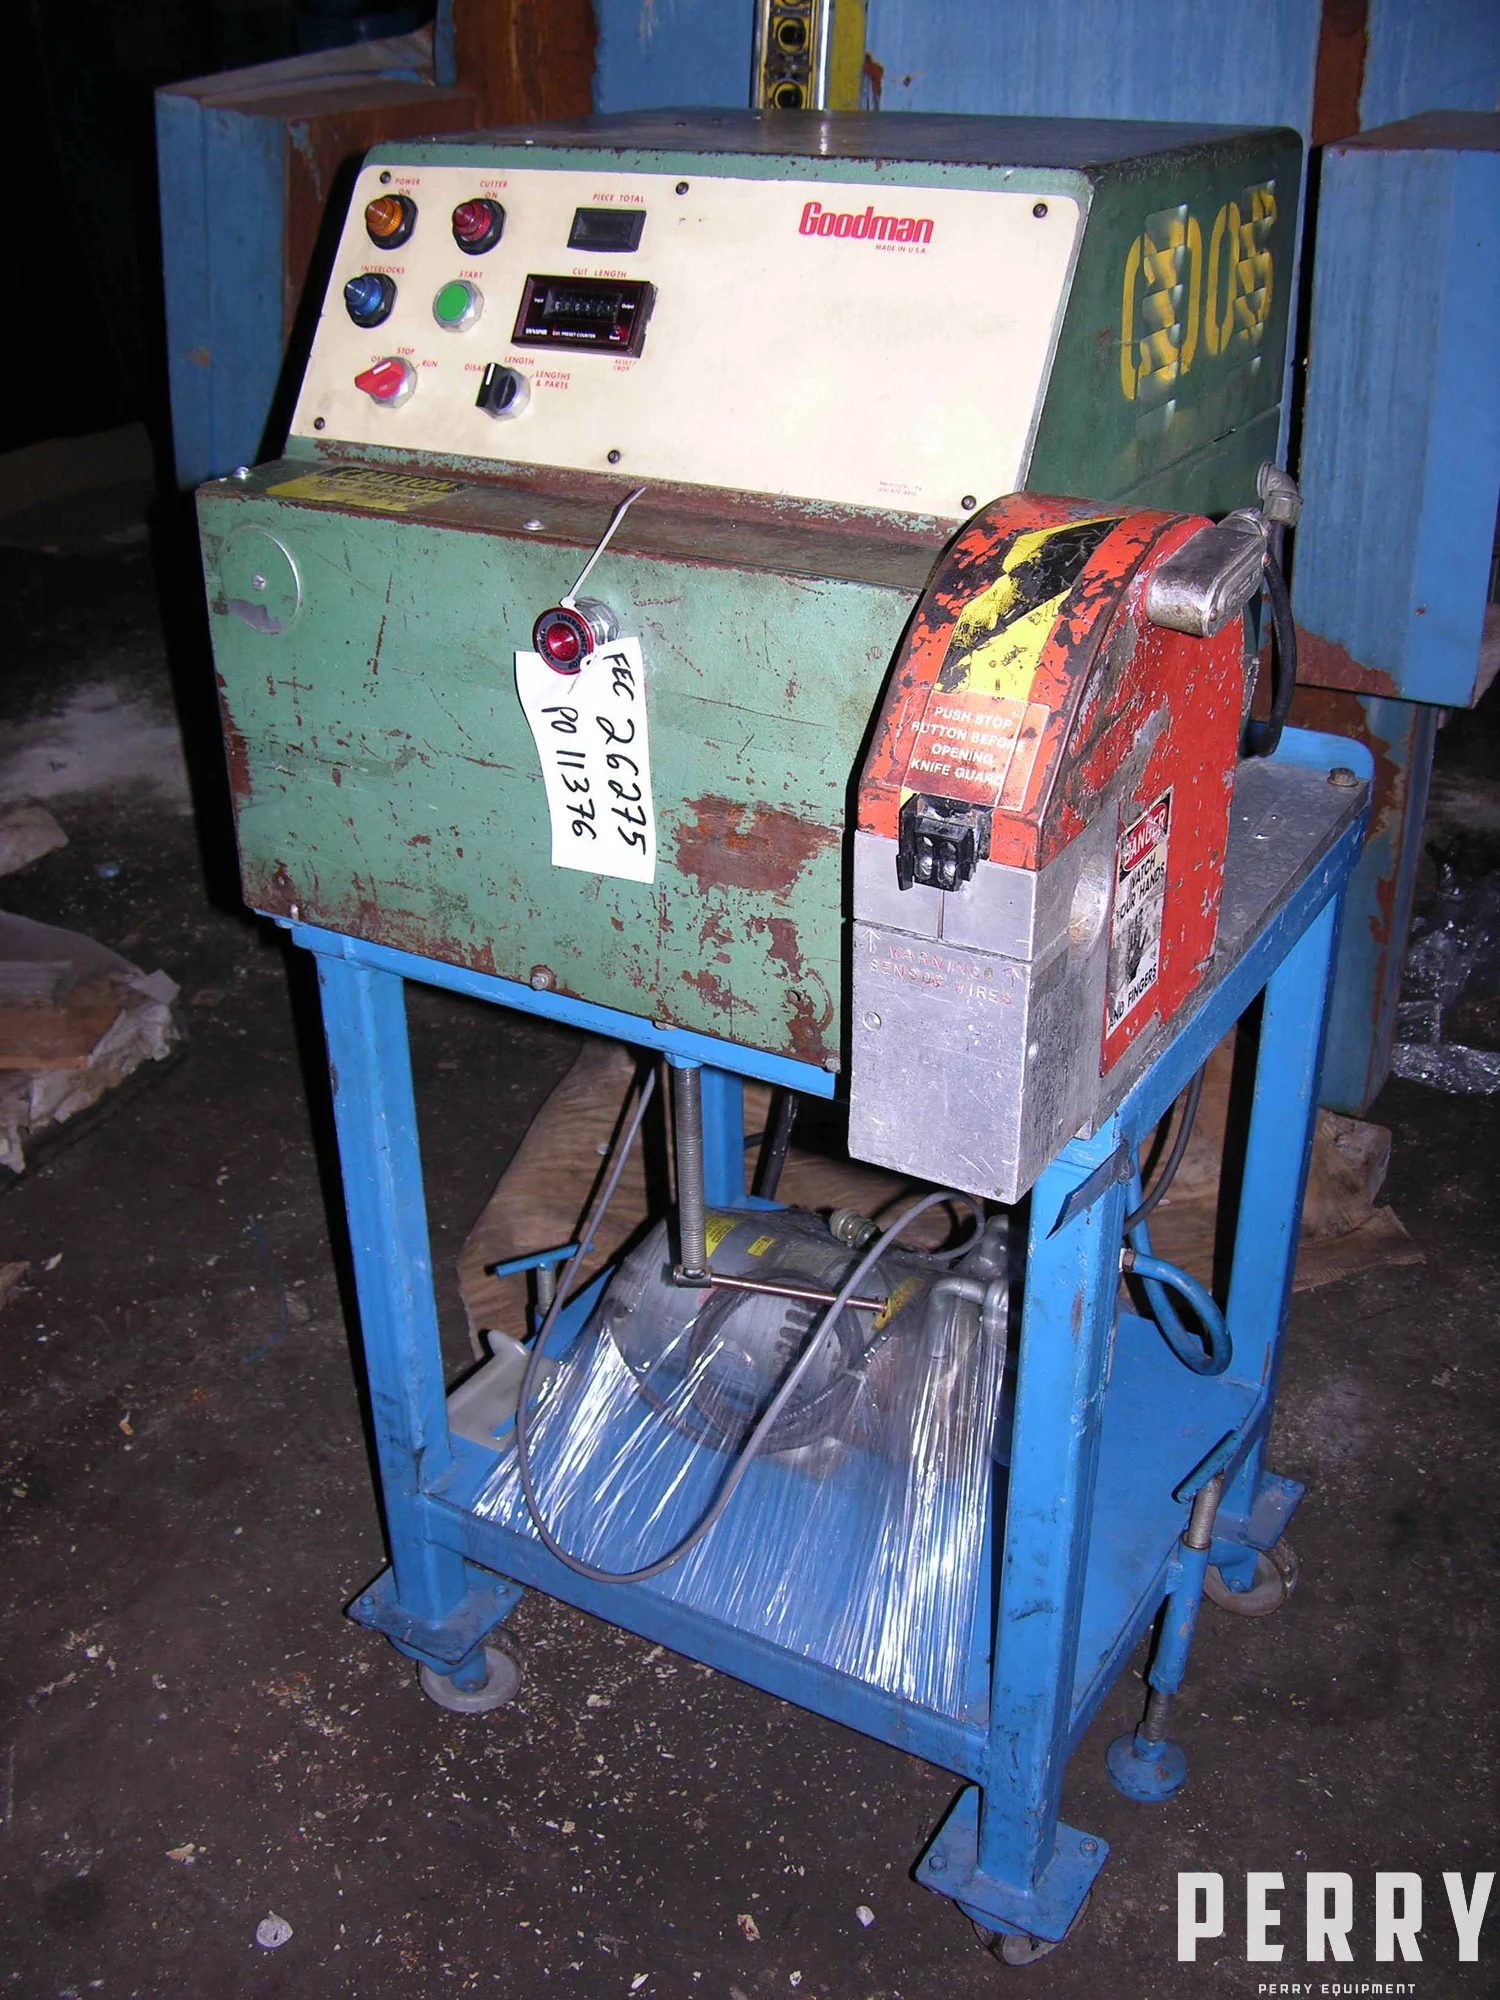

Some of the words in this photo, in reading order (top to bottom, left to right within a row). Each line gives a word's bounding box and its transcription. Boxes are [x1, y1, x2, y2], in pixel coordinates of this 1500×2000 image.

[394, 178, 421, 186] POWER
[480, 180, 508, 188] CUTTER
[398, 188, 411, 196] ON
[484, 191, 498, 199] ON
[592, 193, 614, 201] PIECE
[620, 194, 645, 203] TOTAL
[798, 201, 934, 244] Goodman
[875, 244, 895, 252] MADE
[360, 265, 405, 274] INTERLOCKS
[459, 270, 483, 279] START
[572, 267, 588, 276] CUT
[594, 269, 627, 278] LENGTH
[397, 347, 415, 355] STOP
[422, 360, 438, 368] RUN
[504, 356, 535, 365] LENGTH
[535, 371, 571, 380] LENGTHS
[545, 380, 569, 390] PARTS
[335, 469, 461, 491] CAUTION
[934, 706, 970, 721] PUSH
[975, 711, 1013, 729] STOP
[910, 720, 967, 741] BUTTON
[931, 743, 995, 765] OPENING
[910, 758, 950, 776] KNIFE
[955, 767, 1005, 786] GUARD
[596, 715, 647, 855] 26275
[556, 750, 597, 840] 11376
[1131, 851, 1156, 890] WATCH
[1138, 861, 1165, 901] HANDS
[888, 945, 980, 979] WARNING
[1127, 962, 1157, 1008] FINGERS
[953, 982, 1012, 1007] WIRES
